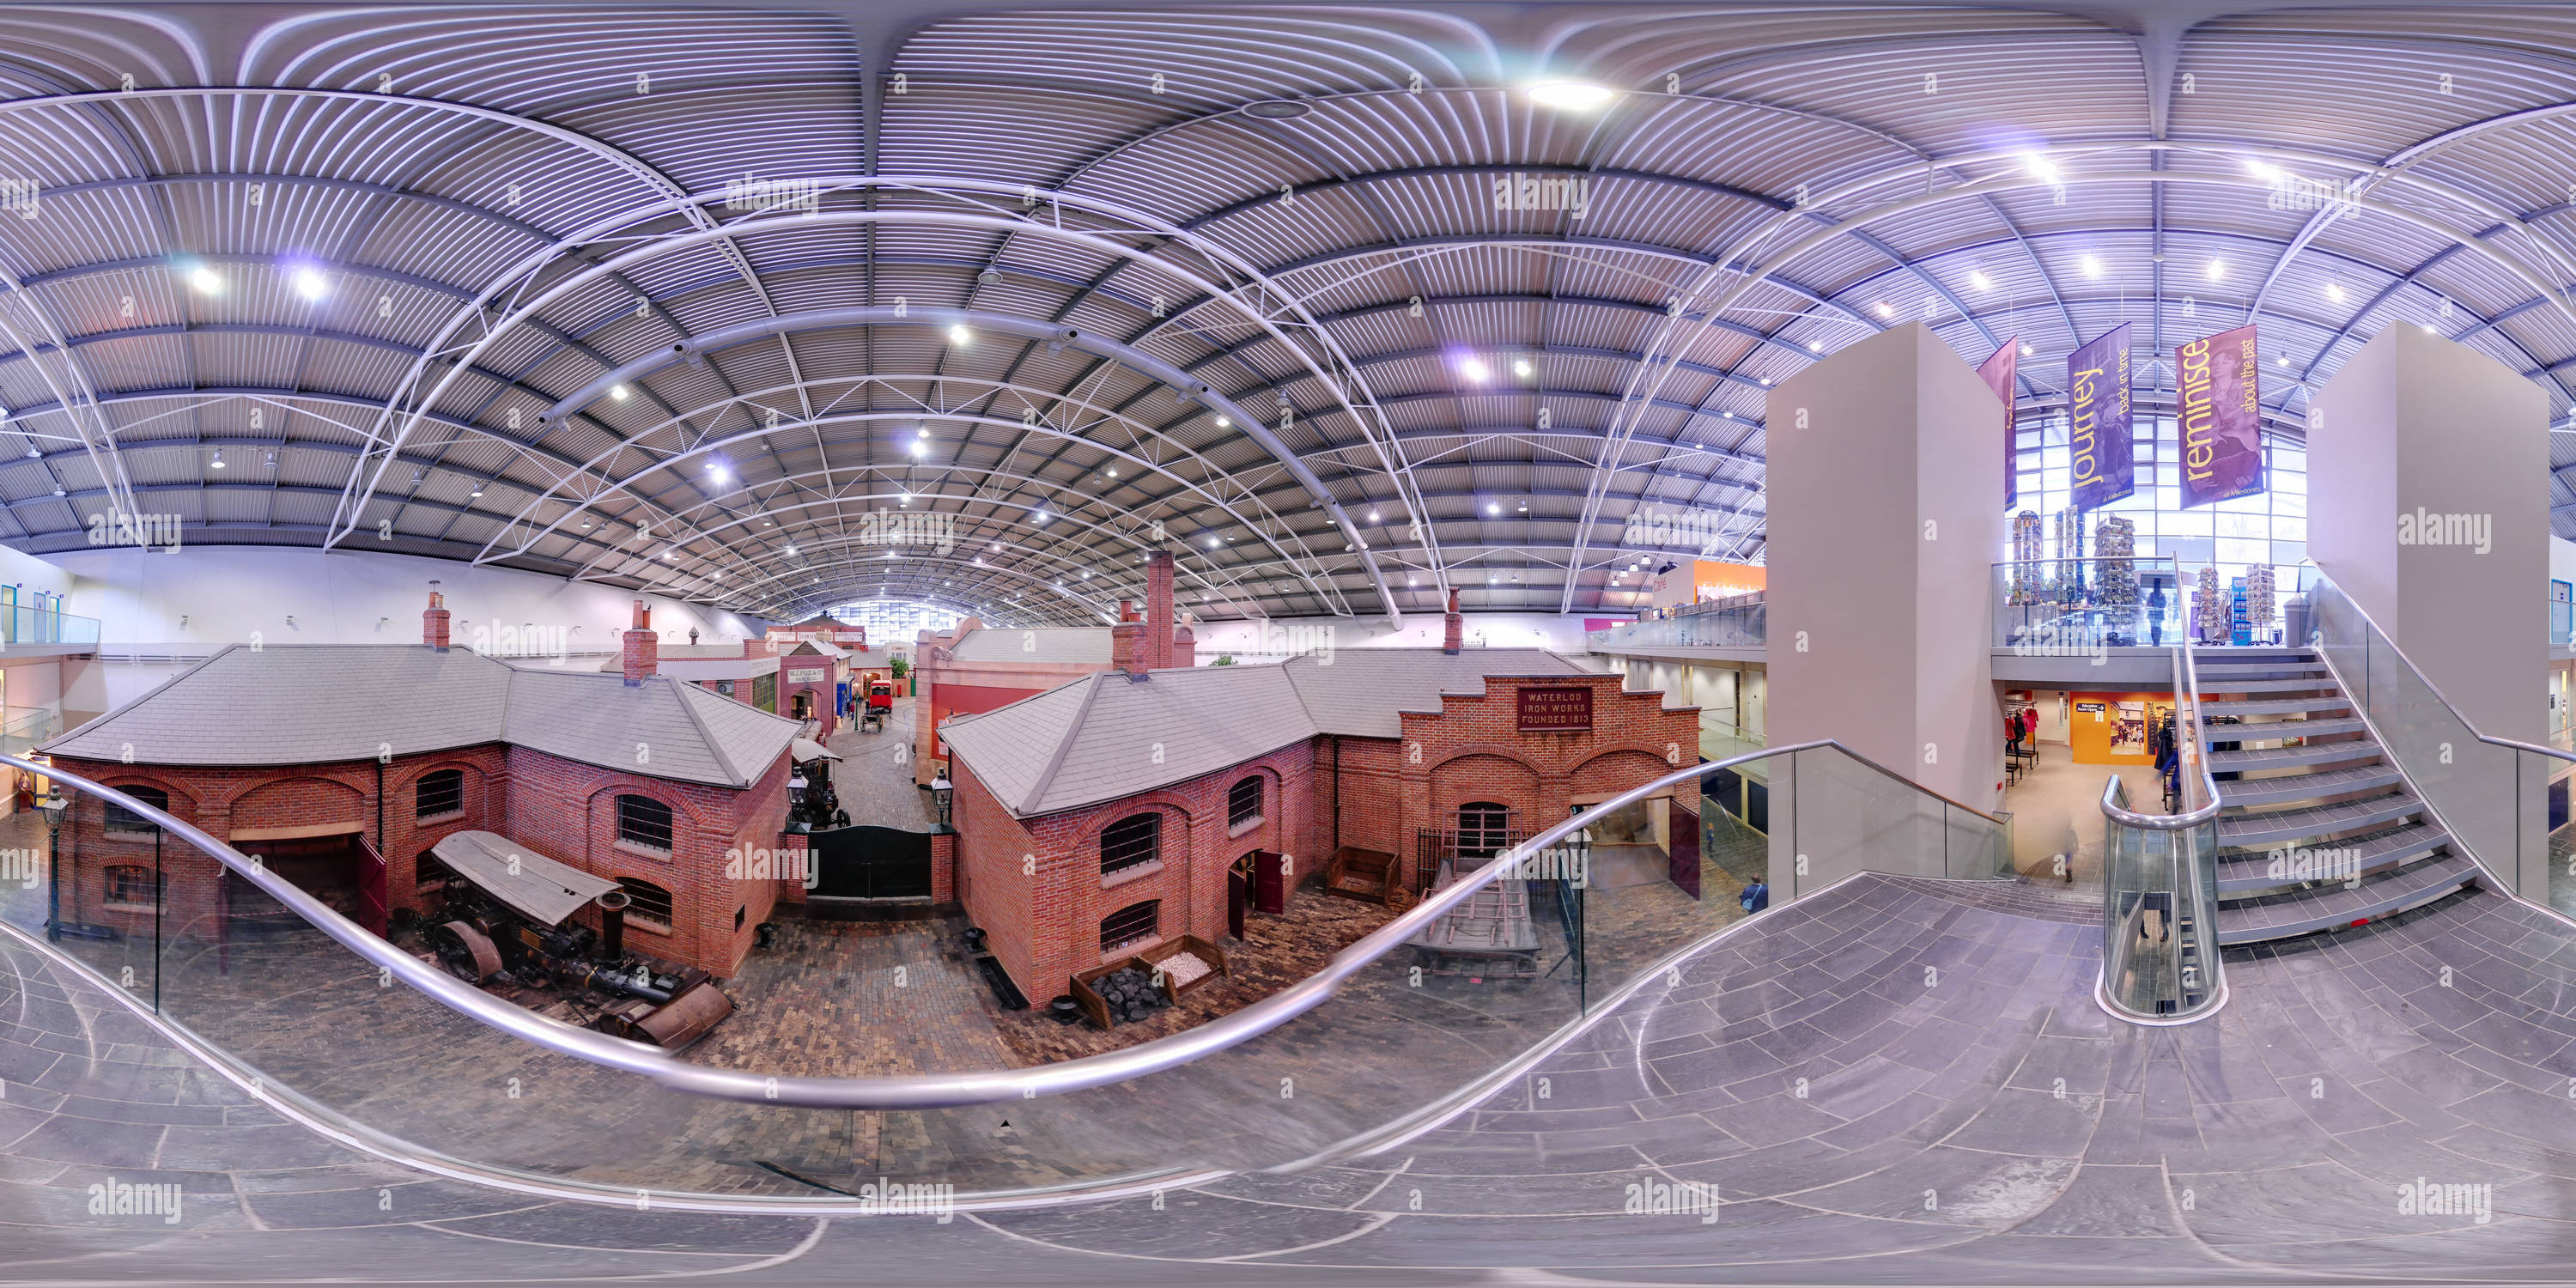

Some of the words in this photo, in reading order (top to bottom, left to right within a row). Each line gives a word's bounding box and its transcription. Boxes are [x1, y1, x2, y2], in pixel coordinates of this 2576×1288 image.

[2118, 347, 2129, 370] time
[2240, 337, 2257, 359] past
[2117, 370, 2129, 385] in
[2243, 357, 2257, 379] the
[2117, 384, 2130, 416] back
[2240, 374, 2257, 414] about
[2177, 339, 2214, 483] reminisce
[1654, 577, 1667, 592] Café
[1522, 715, 1566, 724] FOUNDED
[1552, 704, 1586, 713] WORKS
